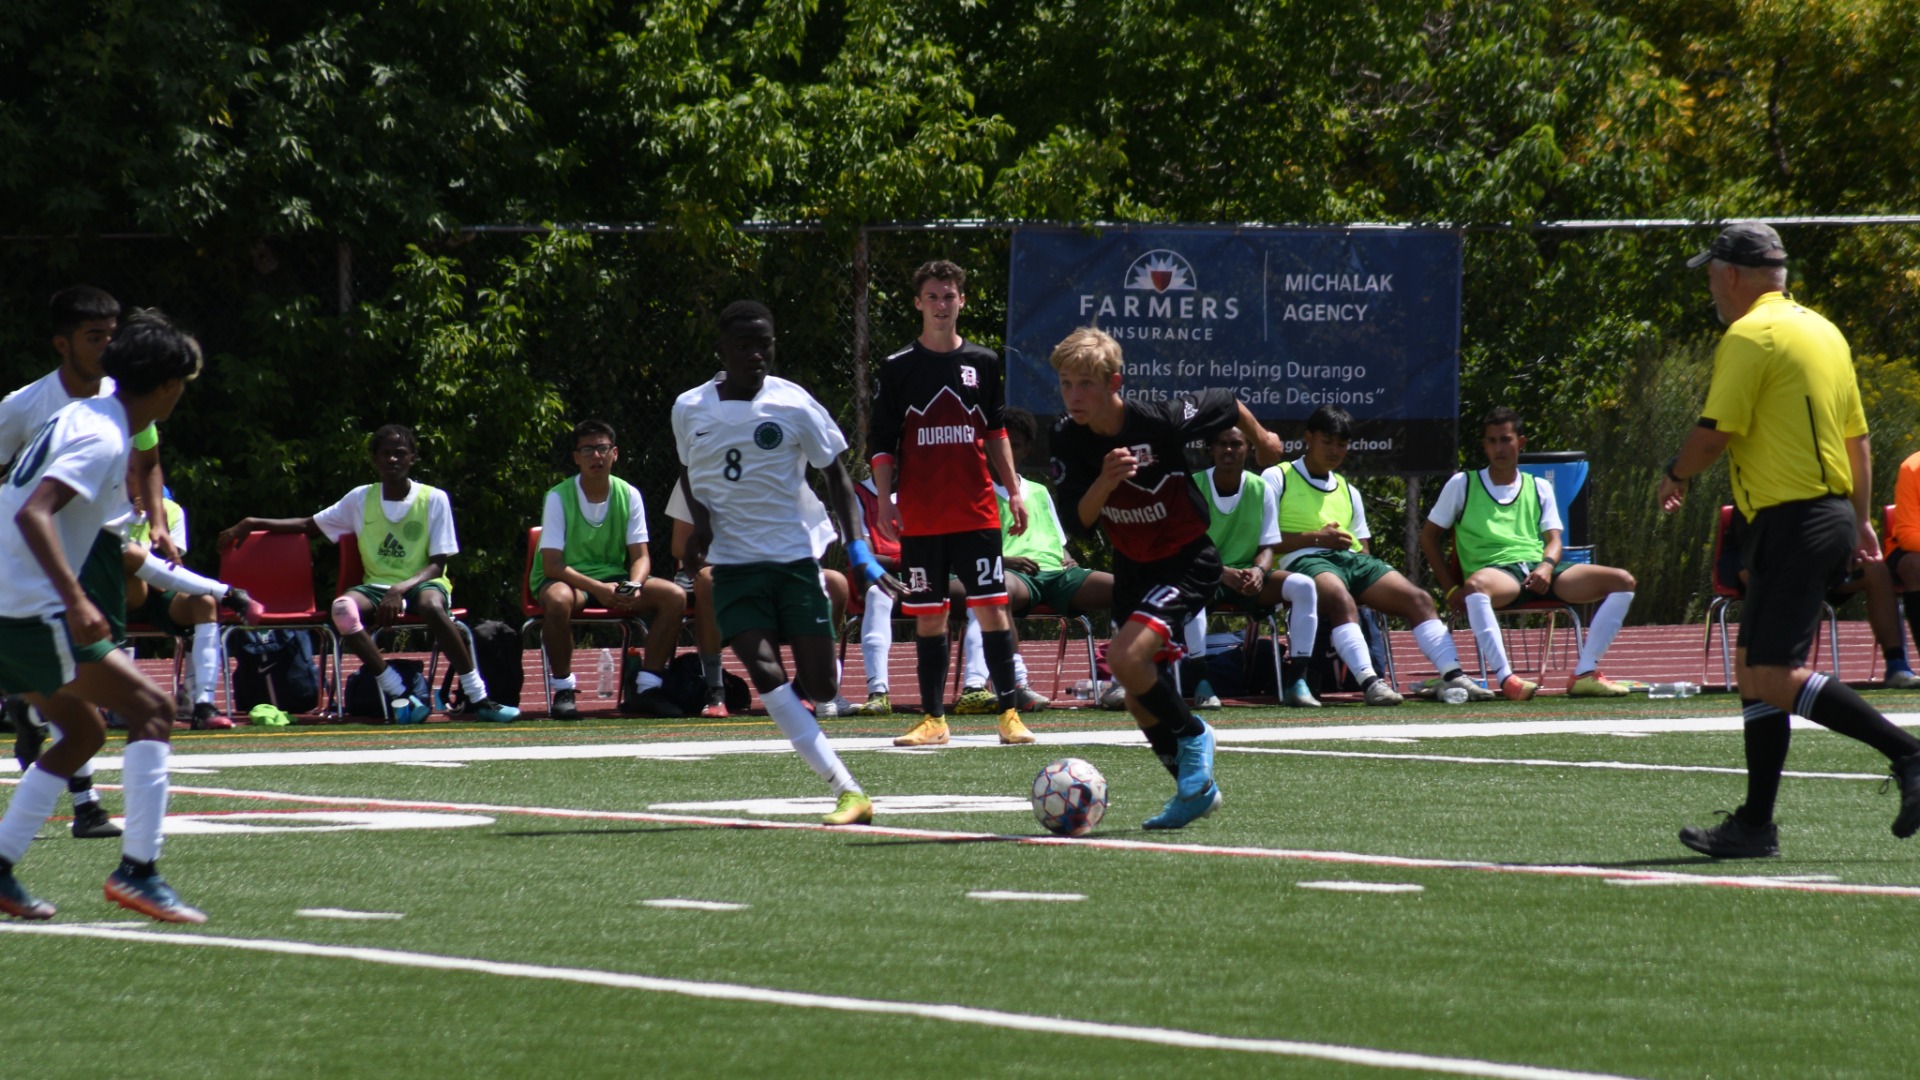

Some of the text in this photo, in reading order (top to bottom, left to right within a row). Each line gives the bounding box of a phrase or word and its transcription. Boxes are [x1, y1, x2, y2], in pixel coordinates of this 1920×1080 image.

[1285, 273, 1393, 292] MICHALAK
[1079, 294, 1239, 320] FARMERS
[1283, 303, 1368, 322] AGENCY
[1119, 358, 1366, 382] hanks for helping Durango
[724, 447, 742, 482] 8
[976, 555, 1005, 587] 24
[1140, 584, 1181, 608] 10
